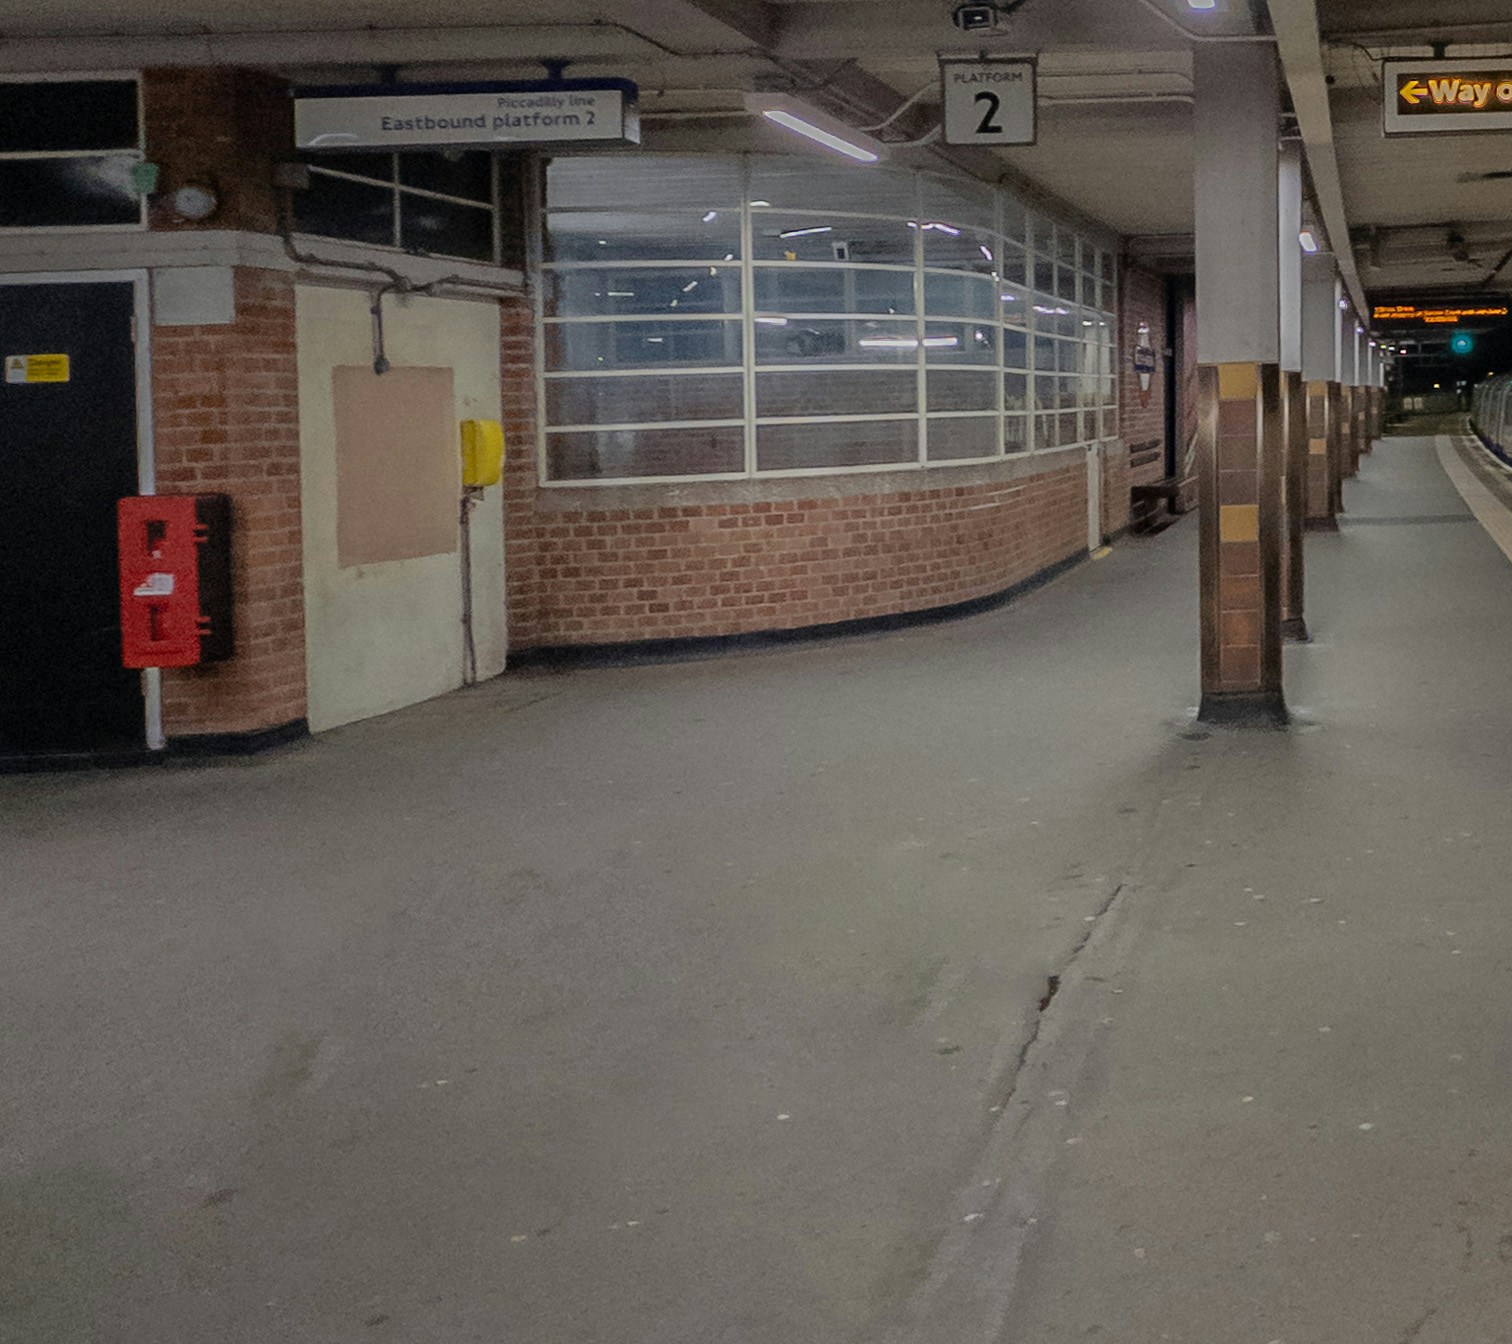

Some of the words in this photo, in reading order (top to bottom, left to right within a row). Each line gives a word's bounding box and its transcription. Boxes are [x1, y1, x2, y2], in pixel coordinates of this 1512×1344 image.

[953, 71, 1023, 84] PLATFORM
[497, 96, 564, 109] Piccadilly
[569, 94, 597, 107] line
[1428, 78, 1492, 108] Way
[381, 114, 486, 131] Eastbound
[493, 112, 581, 131] platform
[586, 110, 597, 125] 2
[974, 91, 1003, 134] 2
